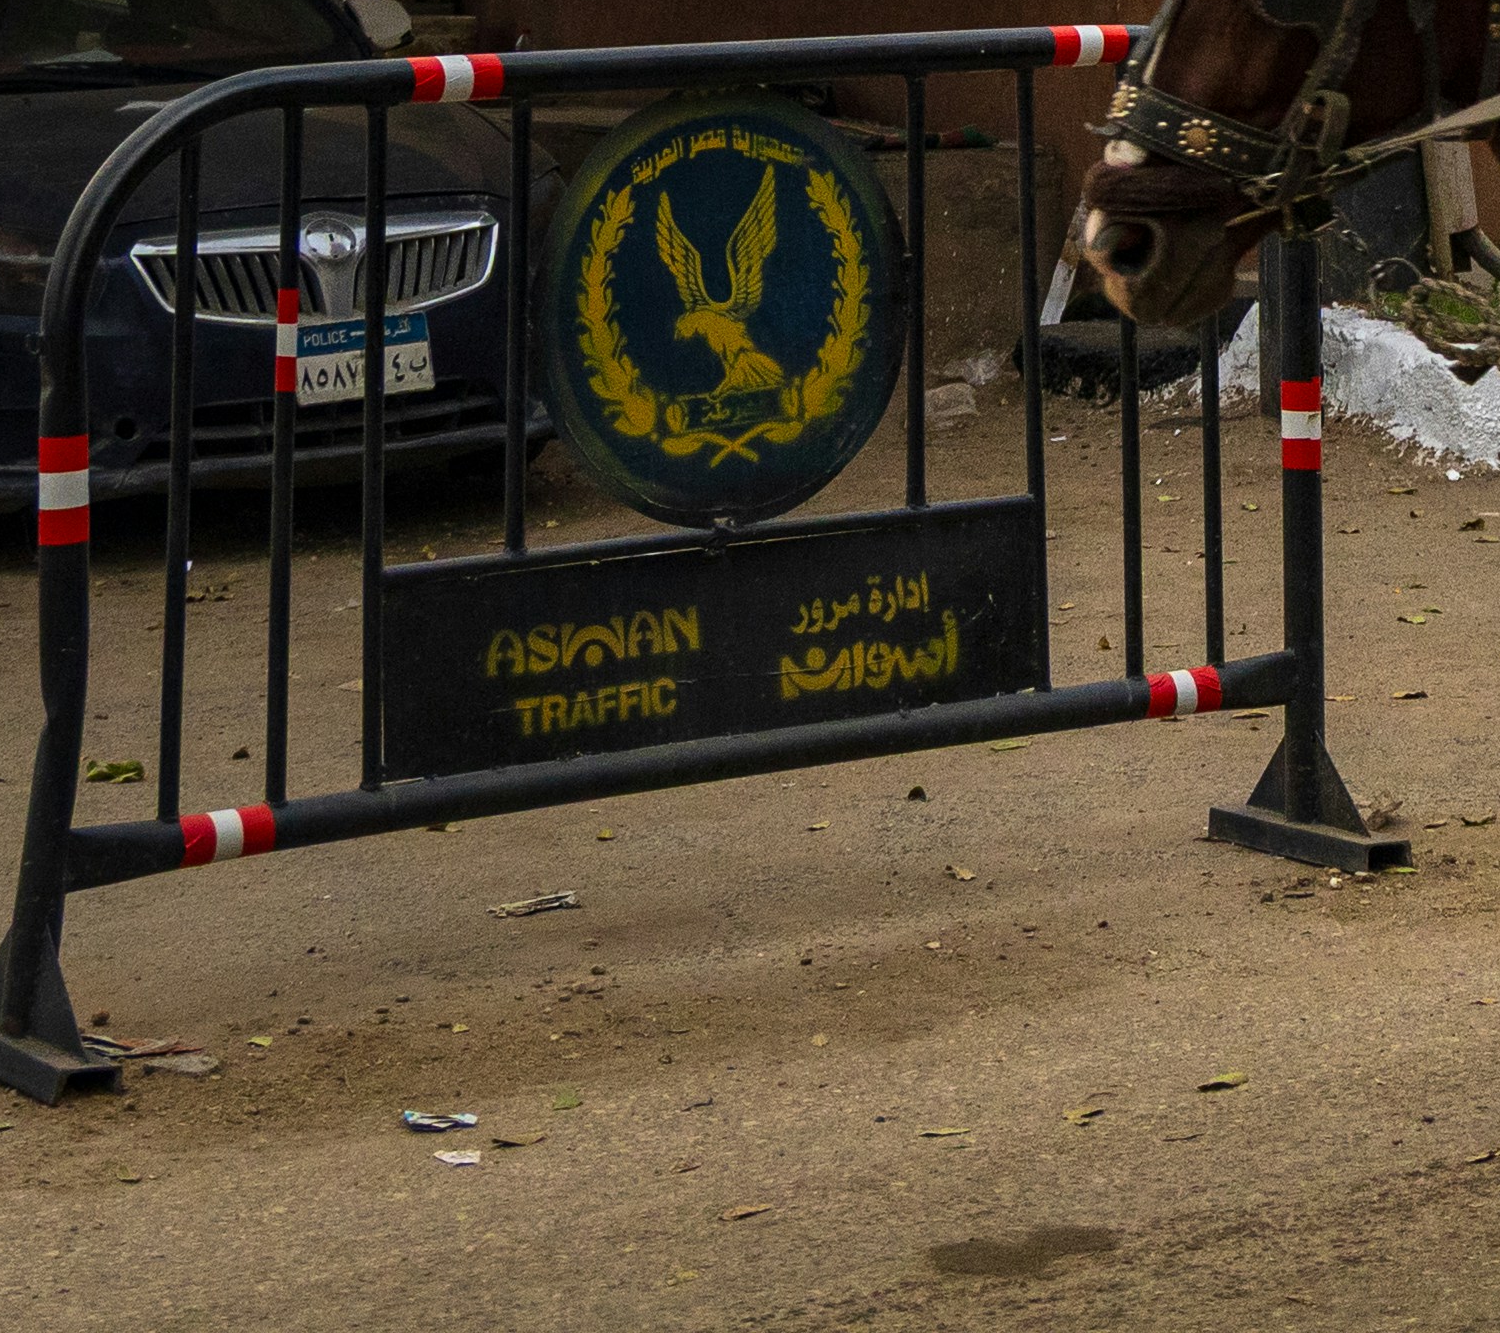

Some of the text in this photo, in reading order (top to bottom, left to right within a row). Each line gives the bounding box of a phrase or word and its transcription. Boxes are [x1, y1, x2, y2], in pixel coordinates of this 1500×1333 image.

[303, 329, 348, 349] POLICE
[790, 593, 862, 634] مرور
[485, 604, 702, 678] ASWAN
[514, 676, 678, 738] TRAFFIC
